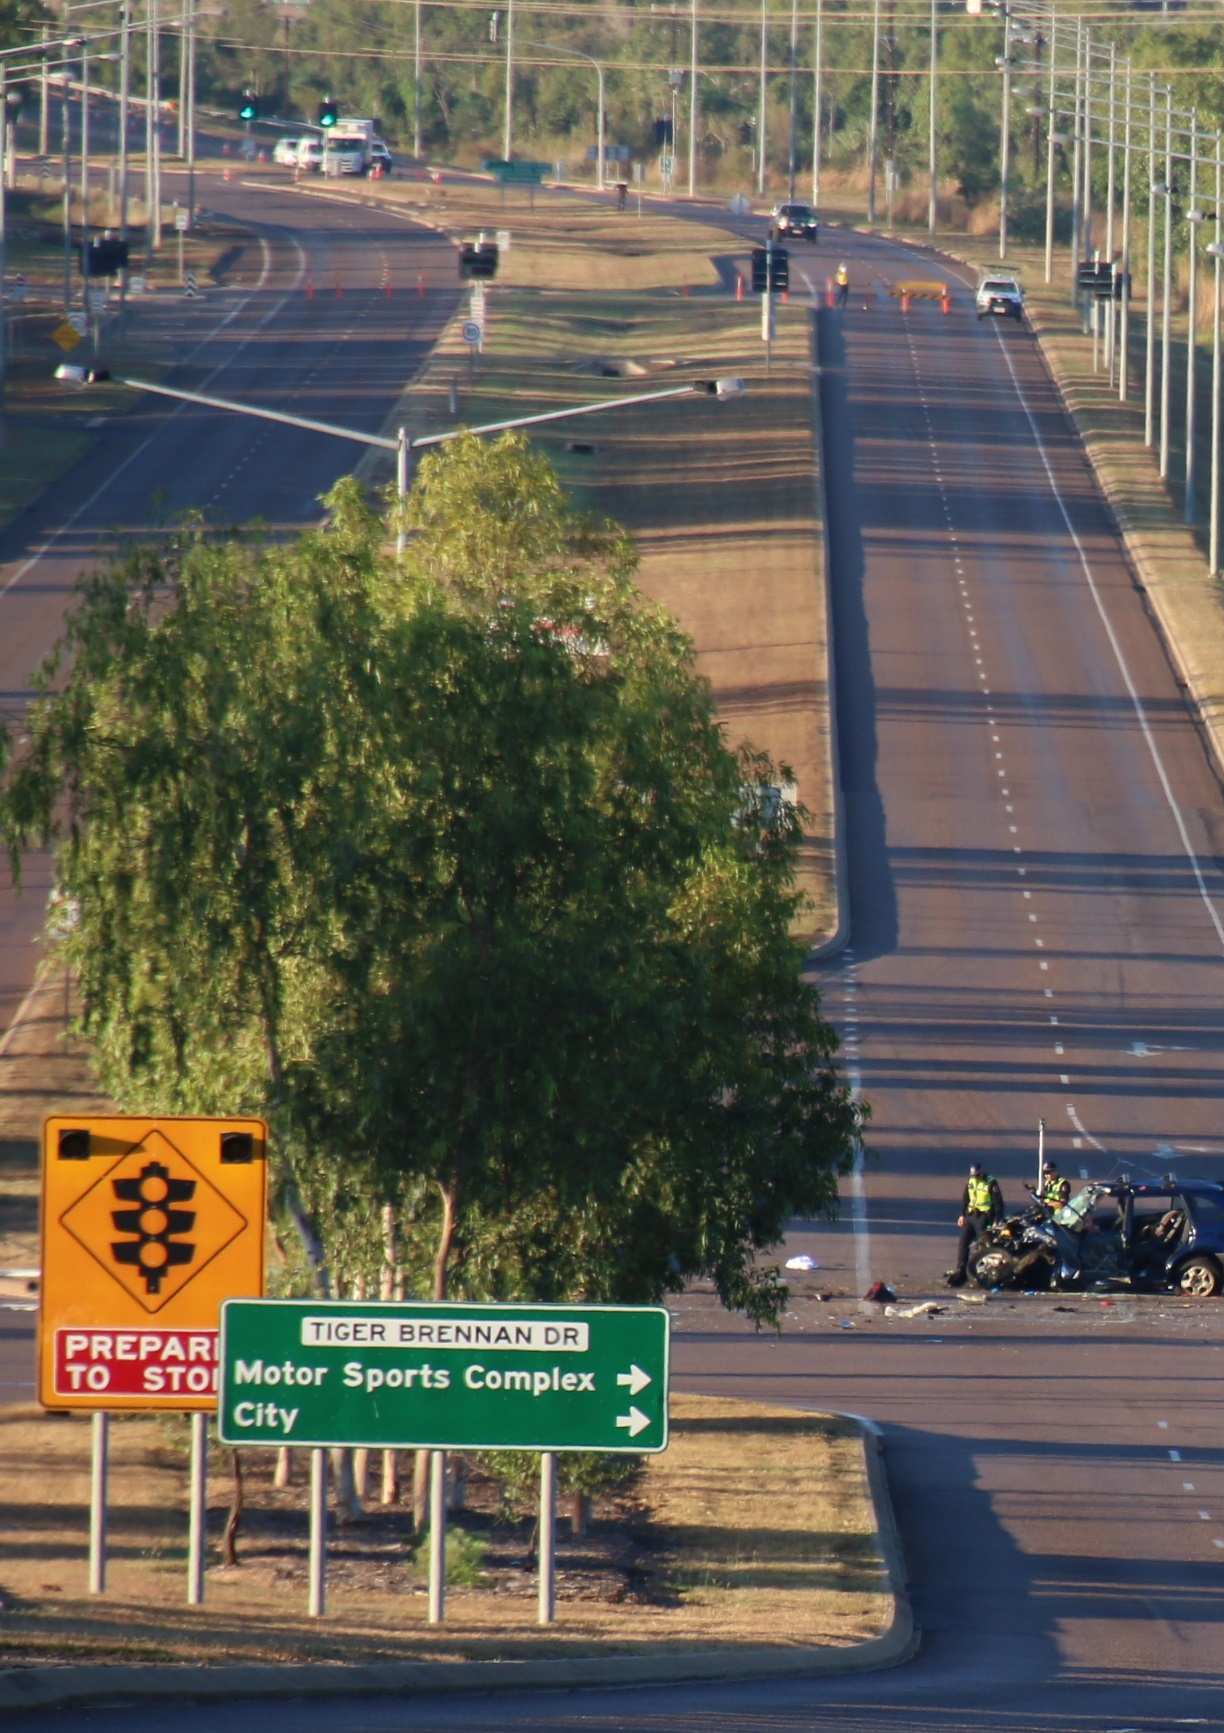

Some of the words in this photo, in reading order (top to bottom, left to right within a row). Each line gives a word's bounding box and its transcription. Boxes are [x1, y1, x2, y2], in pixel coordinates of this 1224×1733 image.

[310, 1322, 386, 1341] TIGER
[400, 1324, 532, 1344] BRENNAN
[544, 1327, 579, 1346] DR
[65, 1364, 110, 1390] TO
[234, 1360, 328, 1386] Motor
[343, 1362, 450, 1393] Sports
[465, 1365, 596, 1396] Complex
[233, 1401, 299, 1434] City
